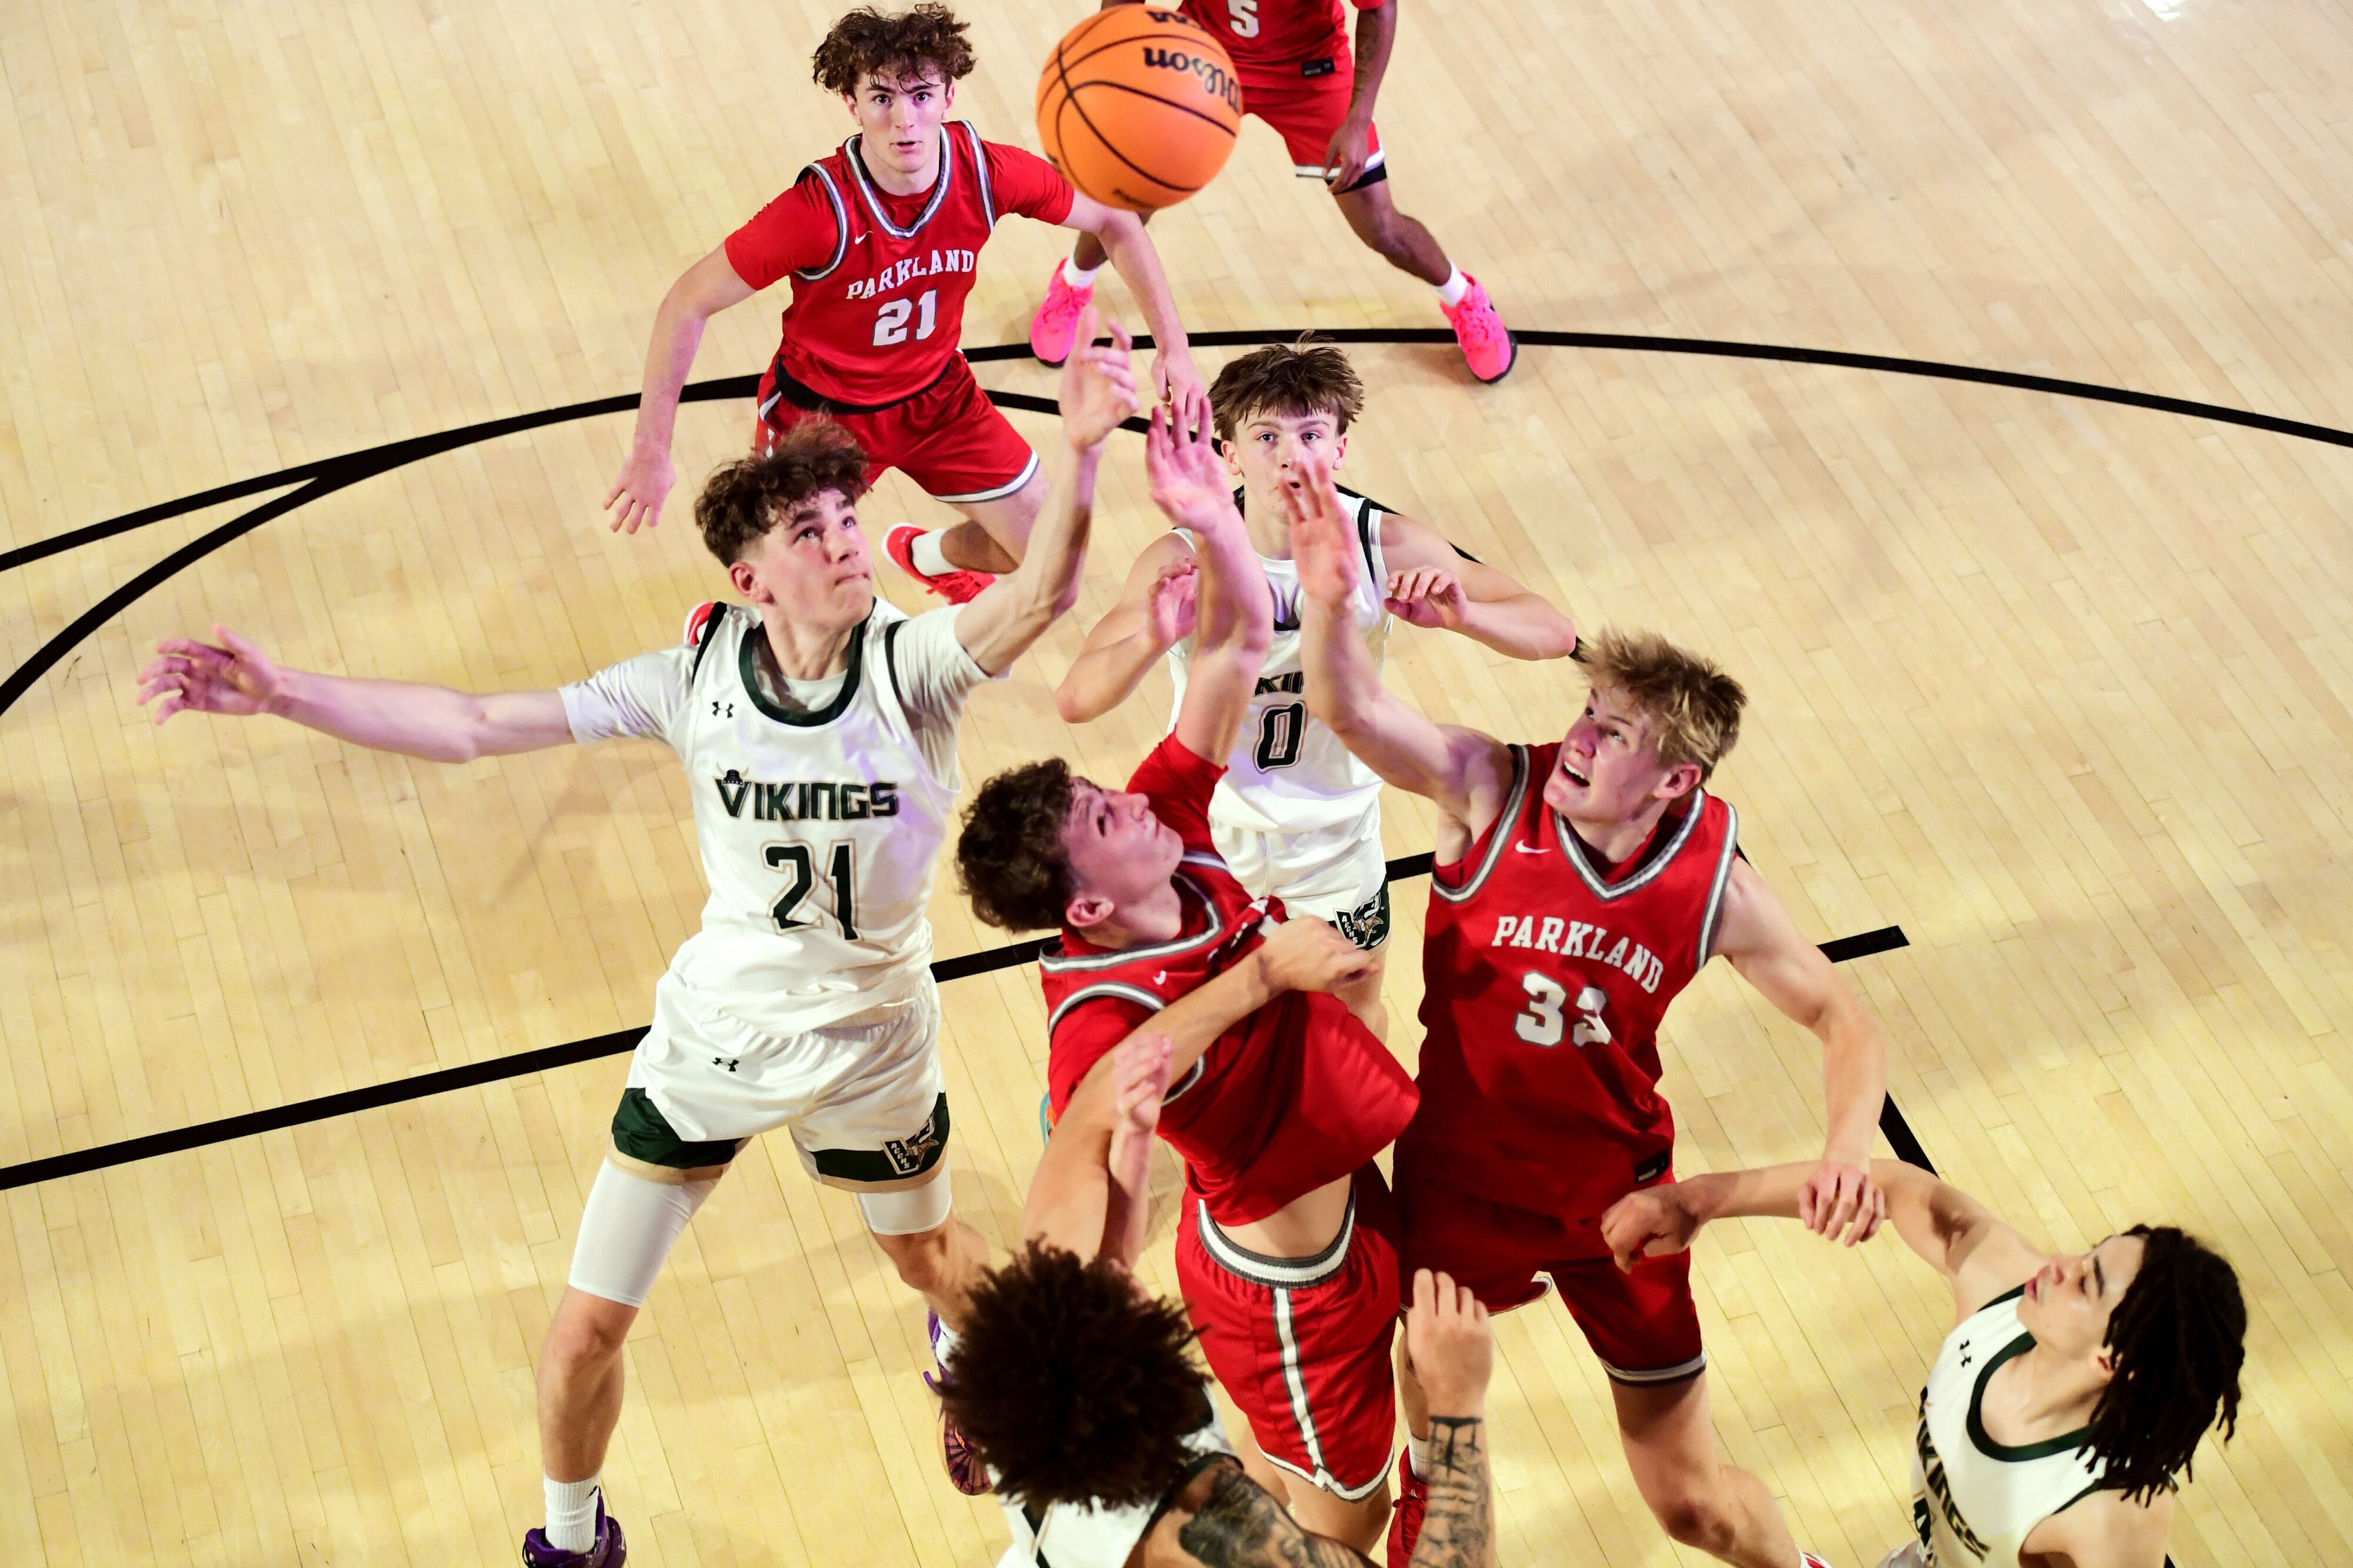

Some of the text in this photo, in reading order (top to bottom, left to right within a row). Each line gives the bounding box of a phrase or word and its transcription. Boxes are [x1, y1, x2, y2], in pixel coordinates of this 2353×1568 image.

[1227, 0, 1259, 38] 5
[845, 249, 974, 299] PARKLAND
[872, 289, 937, 347] 21
[1252, 700, 1309, 775] 0
[714, 778, 901, 821] VIKINGS
[761, 839, 864, 941] 21
[1341, 915, 1358, 943] ACCHS
[1491, 915, 1664, 994] PARKLAND
[891, 1143, 910, 1169] ACCHS
